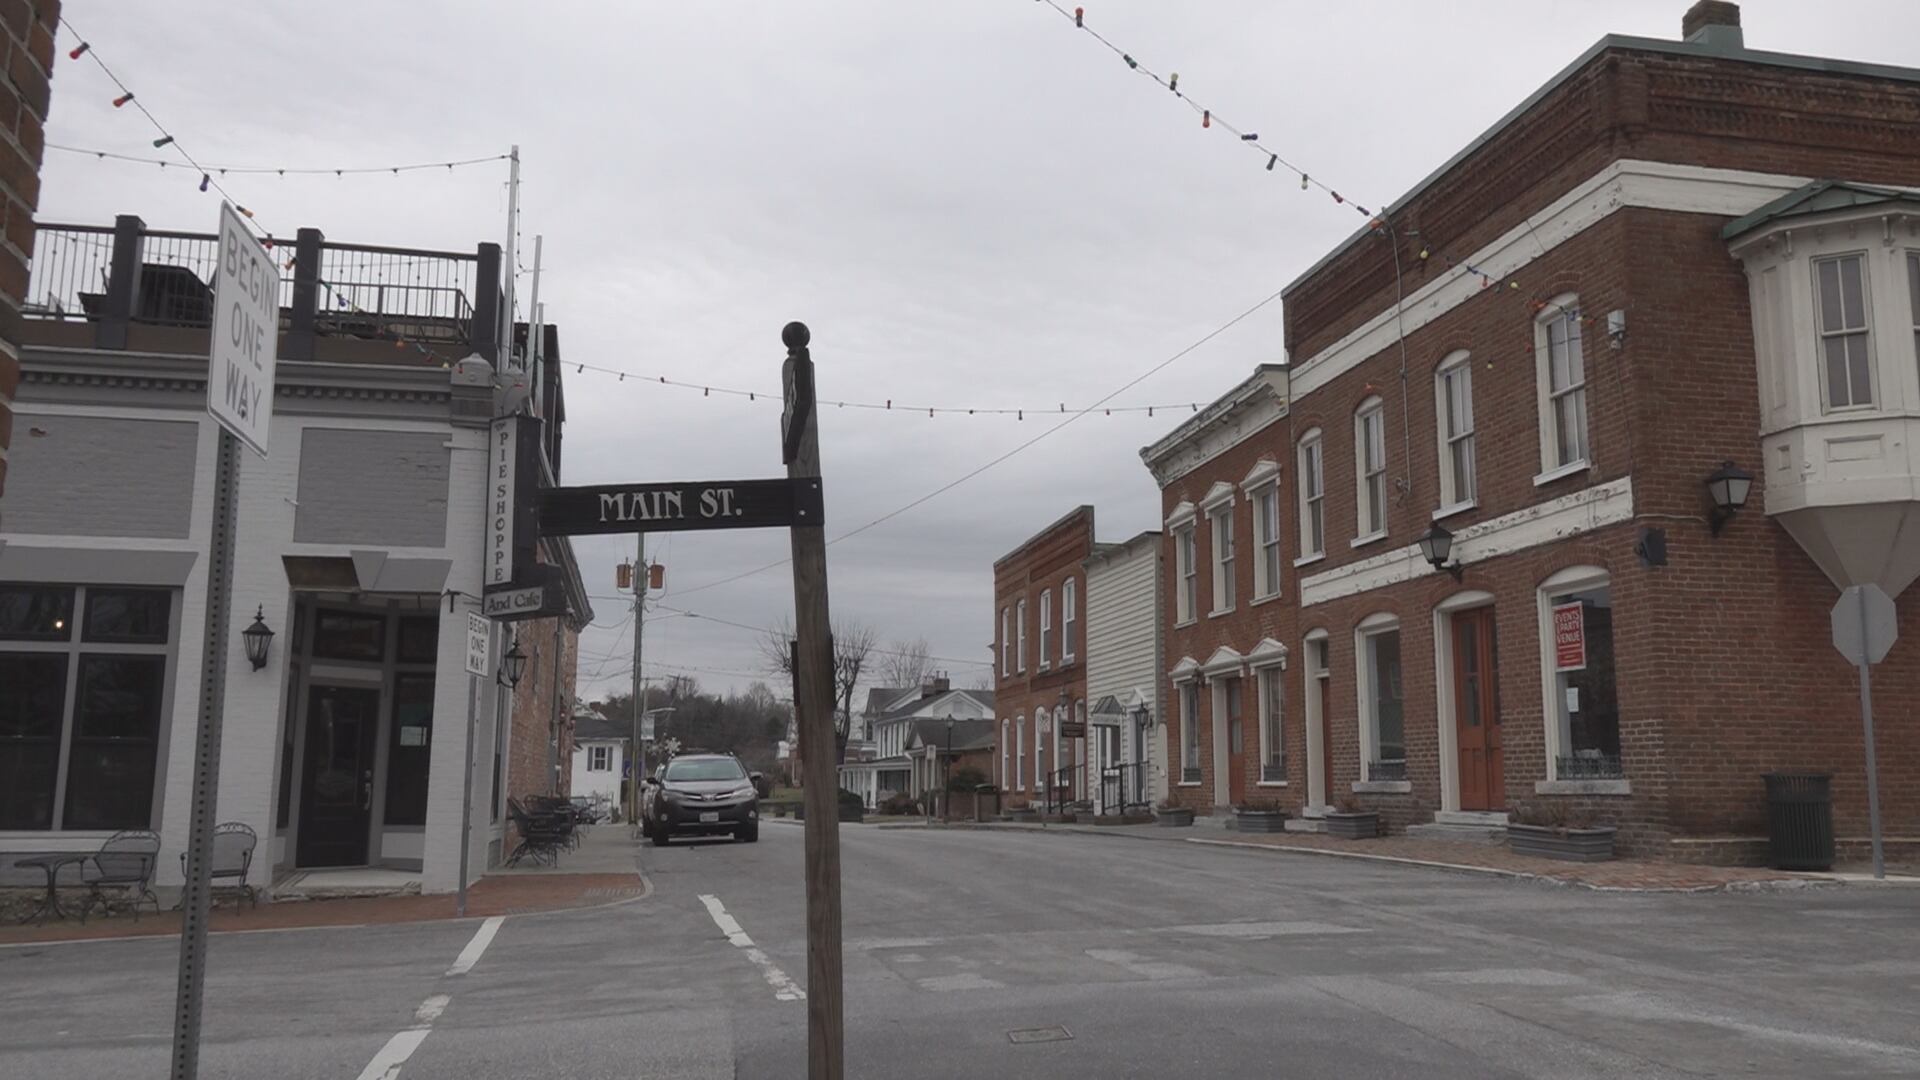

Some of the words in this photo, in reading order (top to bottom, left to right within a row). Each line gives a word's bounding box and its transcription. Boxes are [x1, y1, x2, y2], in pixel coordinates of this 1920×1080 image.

[225, 228, 275, 322] BEGIN
[231, 301, 264, 371] ONE
[225, 358, 262, 428] WAY
[598, 490, 685, 522] MAIN
[699, 488, 743, 518] ST.
[486, 595, 511, 613] And
[469, 615, 489, 636] BEGIN
[1555, 610, 1580, 624] EVENTS
[471, 636, 485, 654] ONE
[1557, 631, 1581, 645] VENUE
[469, 654, 484, 673] WAY
